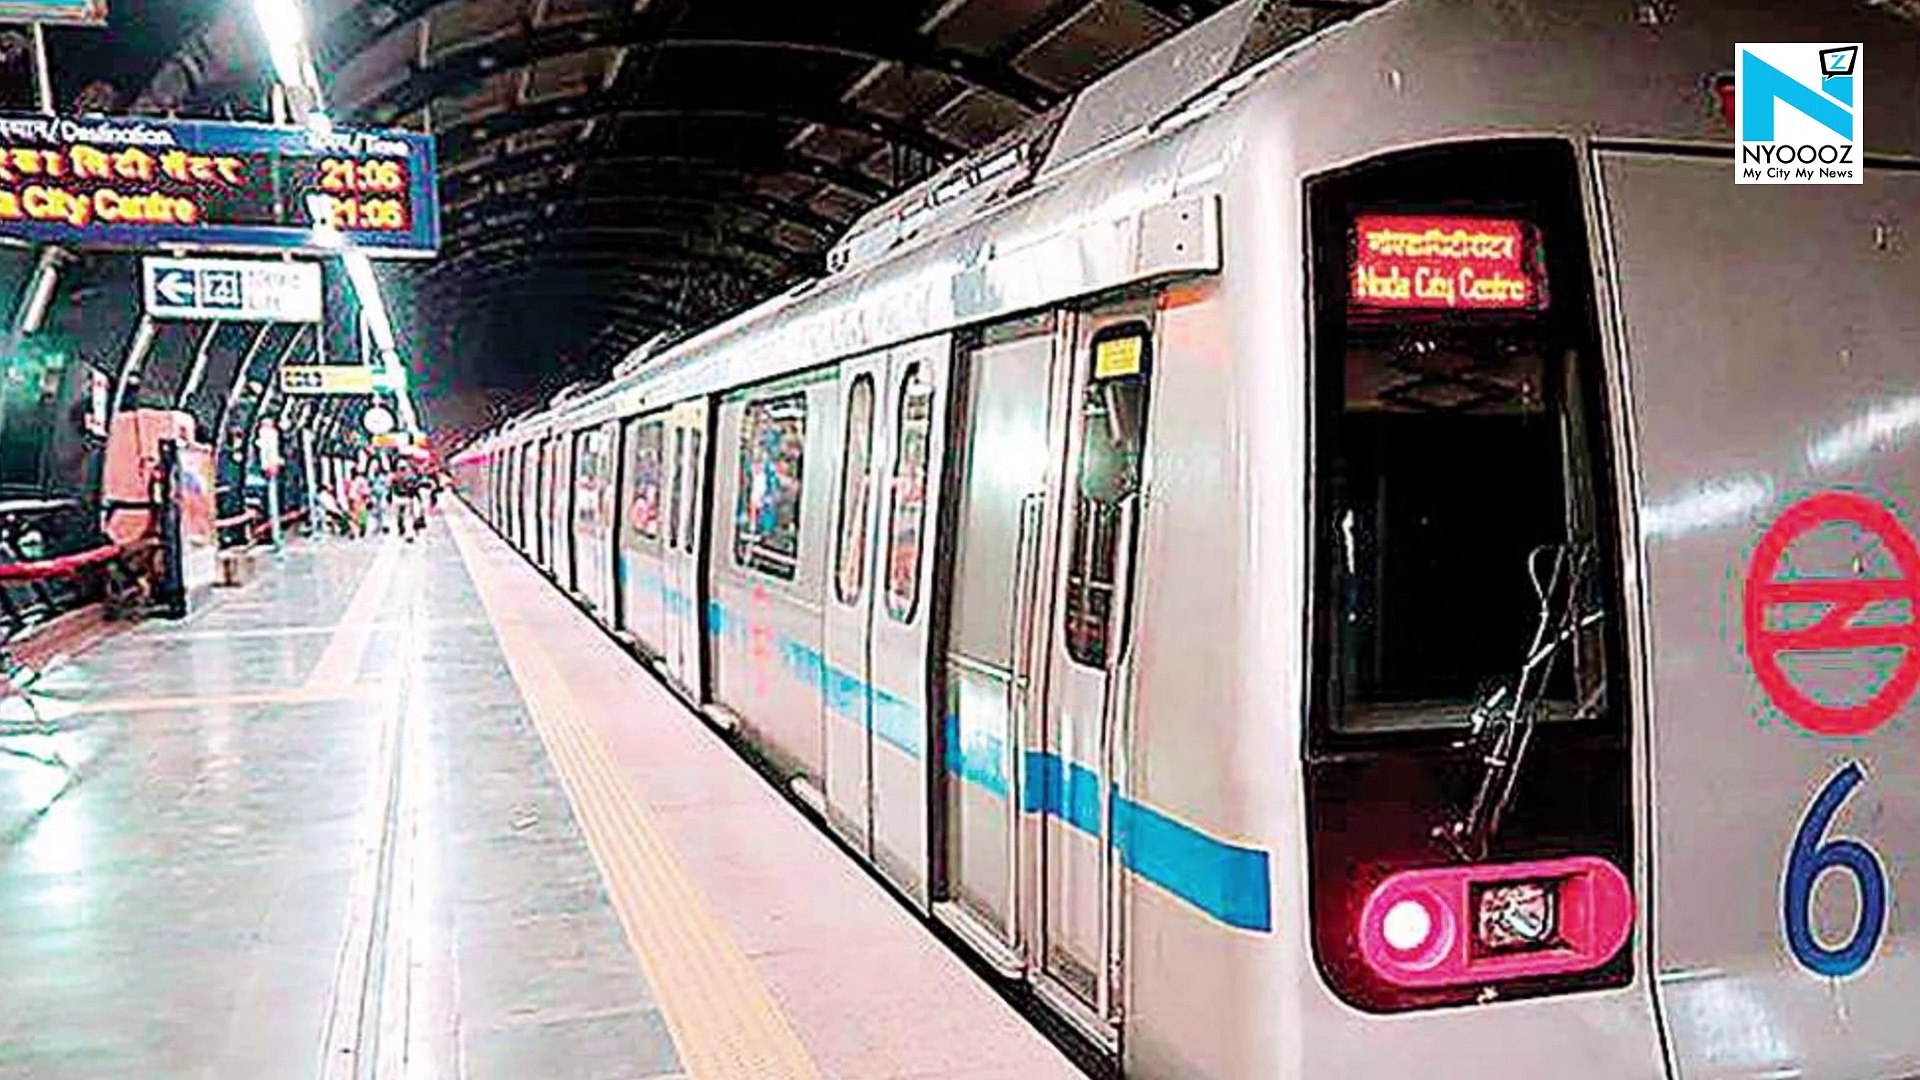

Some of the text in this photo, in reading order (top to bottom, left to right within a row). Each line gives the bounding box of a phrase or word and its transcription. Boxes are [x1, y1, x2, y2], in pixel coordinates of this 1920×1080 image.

[22, 185, 90, 227] City
[94, 188, 199, 224] Centre
[1415, 266, 1456, 307] City
[1459, 267, 1525, 302] Centre
[1782, 762, 1887, 978] 6
